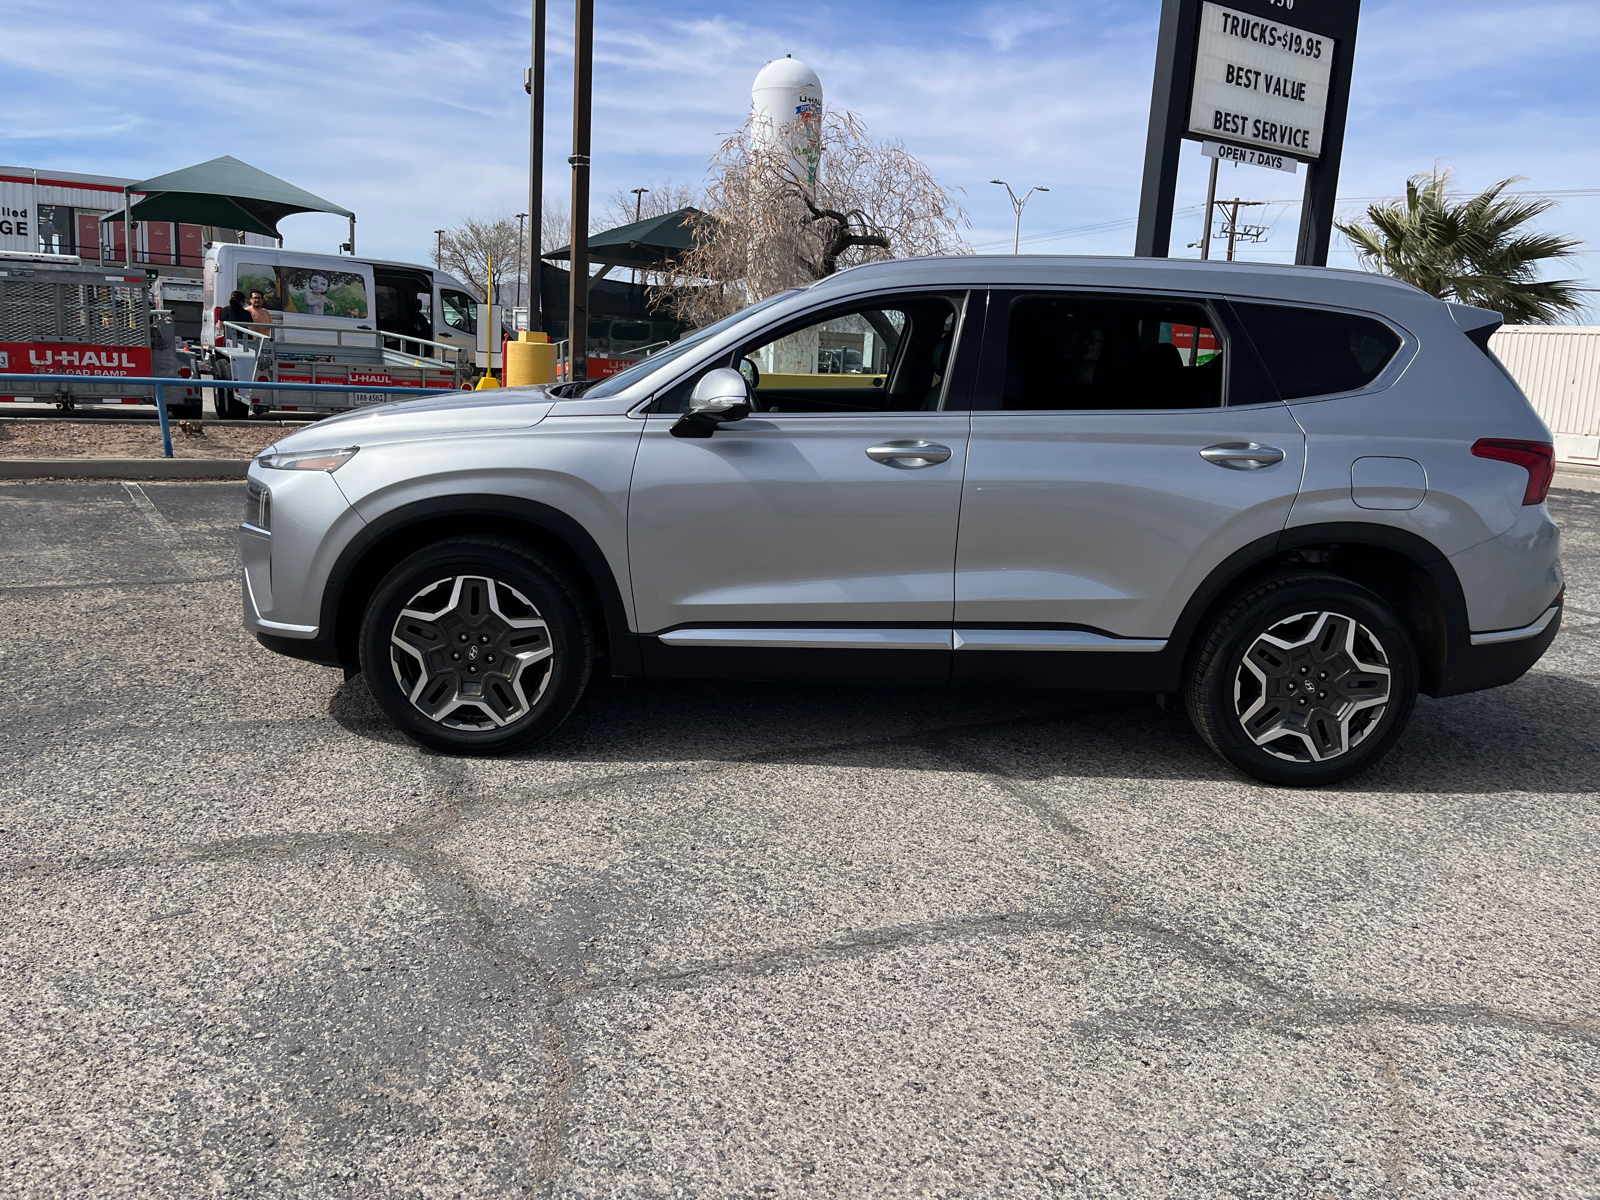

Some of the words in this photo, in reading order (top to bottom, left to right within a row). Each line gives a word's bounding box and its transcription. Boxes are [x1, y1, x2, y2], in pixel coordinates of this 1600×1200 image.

[1222, 12, 1322, 59] TRUCKS-$19.95
[1225, 64, 1261, 91] BEST
[1264, 74, 1306, 101] VALUE
[1213, 110, 1248, 135] BEST
[1252, 119, 1310, 149] SERVICE
[1218, 145, 1247, 162] OPEN
[1249, 152, 1255, 163] 7
[1257, 154, 1283, 169] DAYS
[0, 220, 28, 236] GE
[28, 349, 136, 368] U-HAUL
[349, 374, 392, 383] U-HAUL
